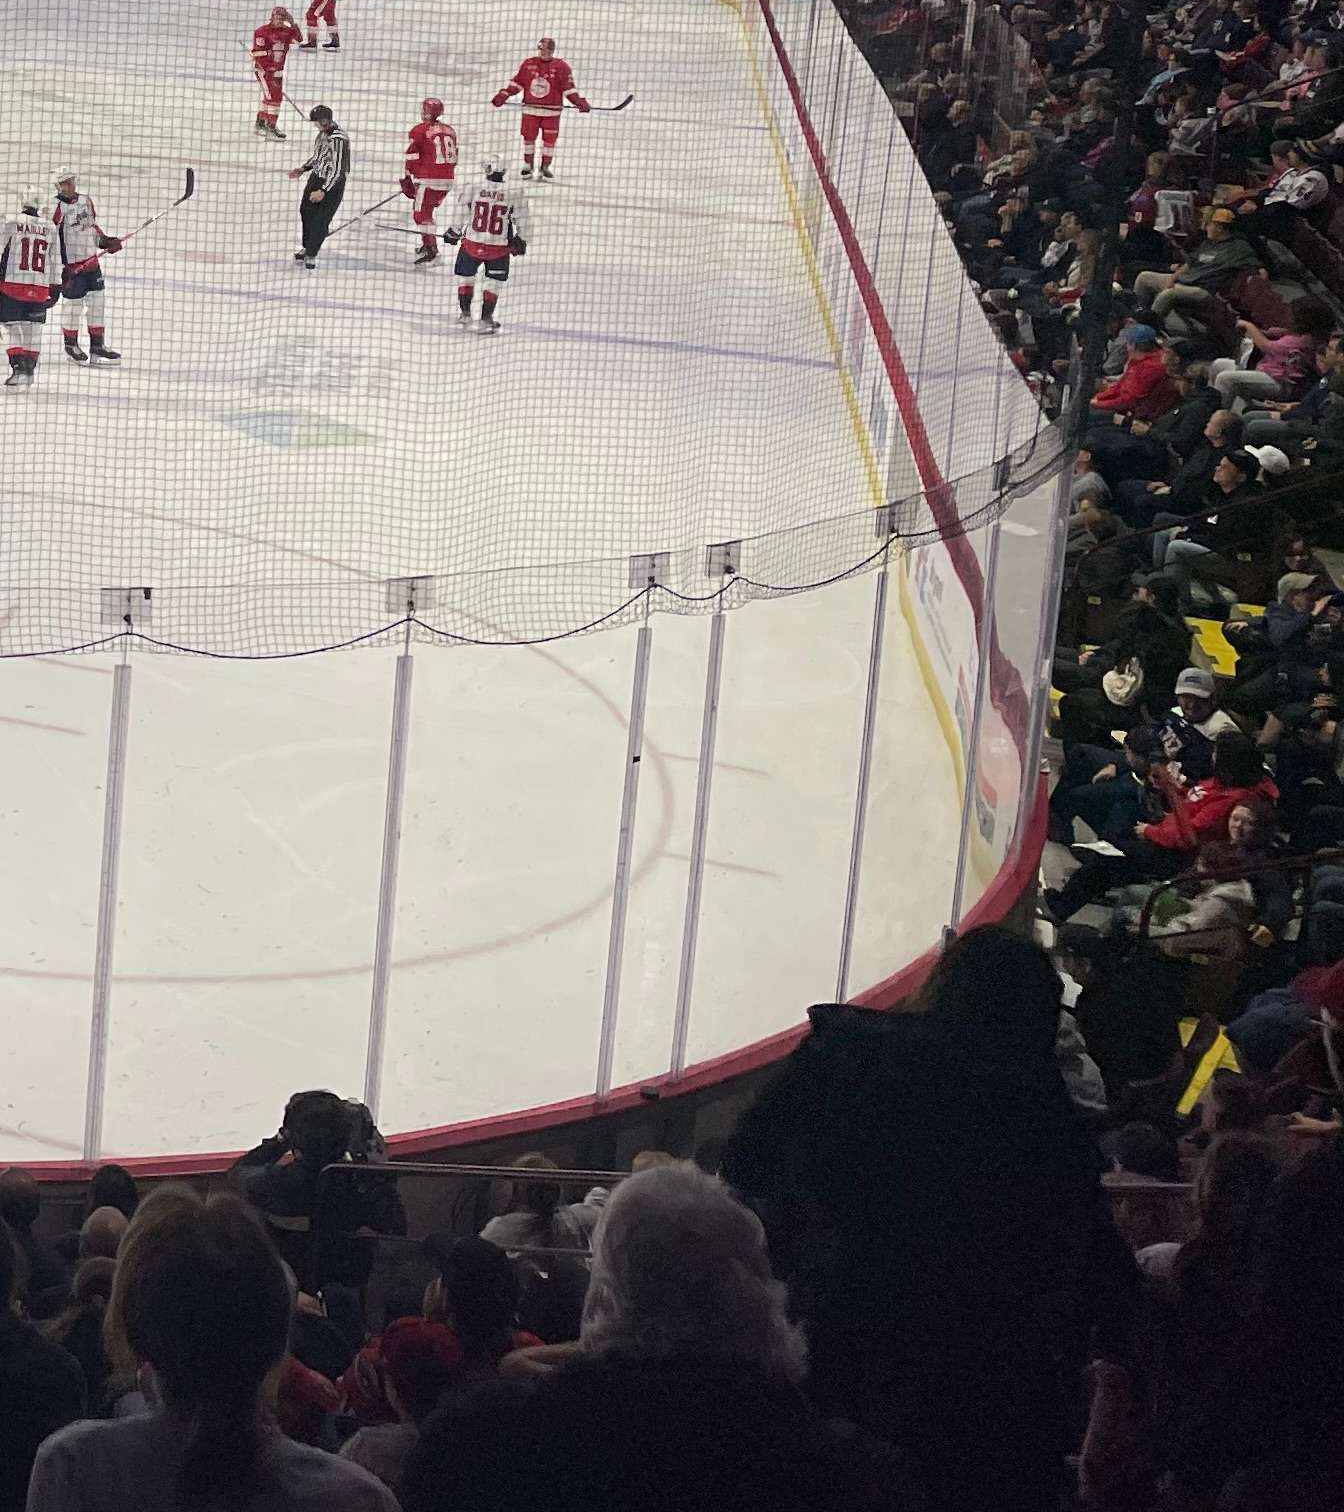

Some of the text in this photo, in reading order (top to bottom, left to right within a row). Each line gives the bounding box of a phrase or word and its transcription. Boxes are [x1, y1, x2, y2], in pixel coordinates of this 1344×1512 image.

[434, 135, 458, 165] 18
[472, 200, 509, 235] 86
[19, 237, 48, 273] 16
